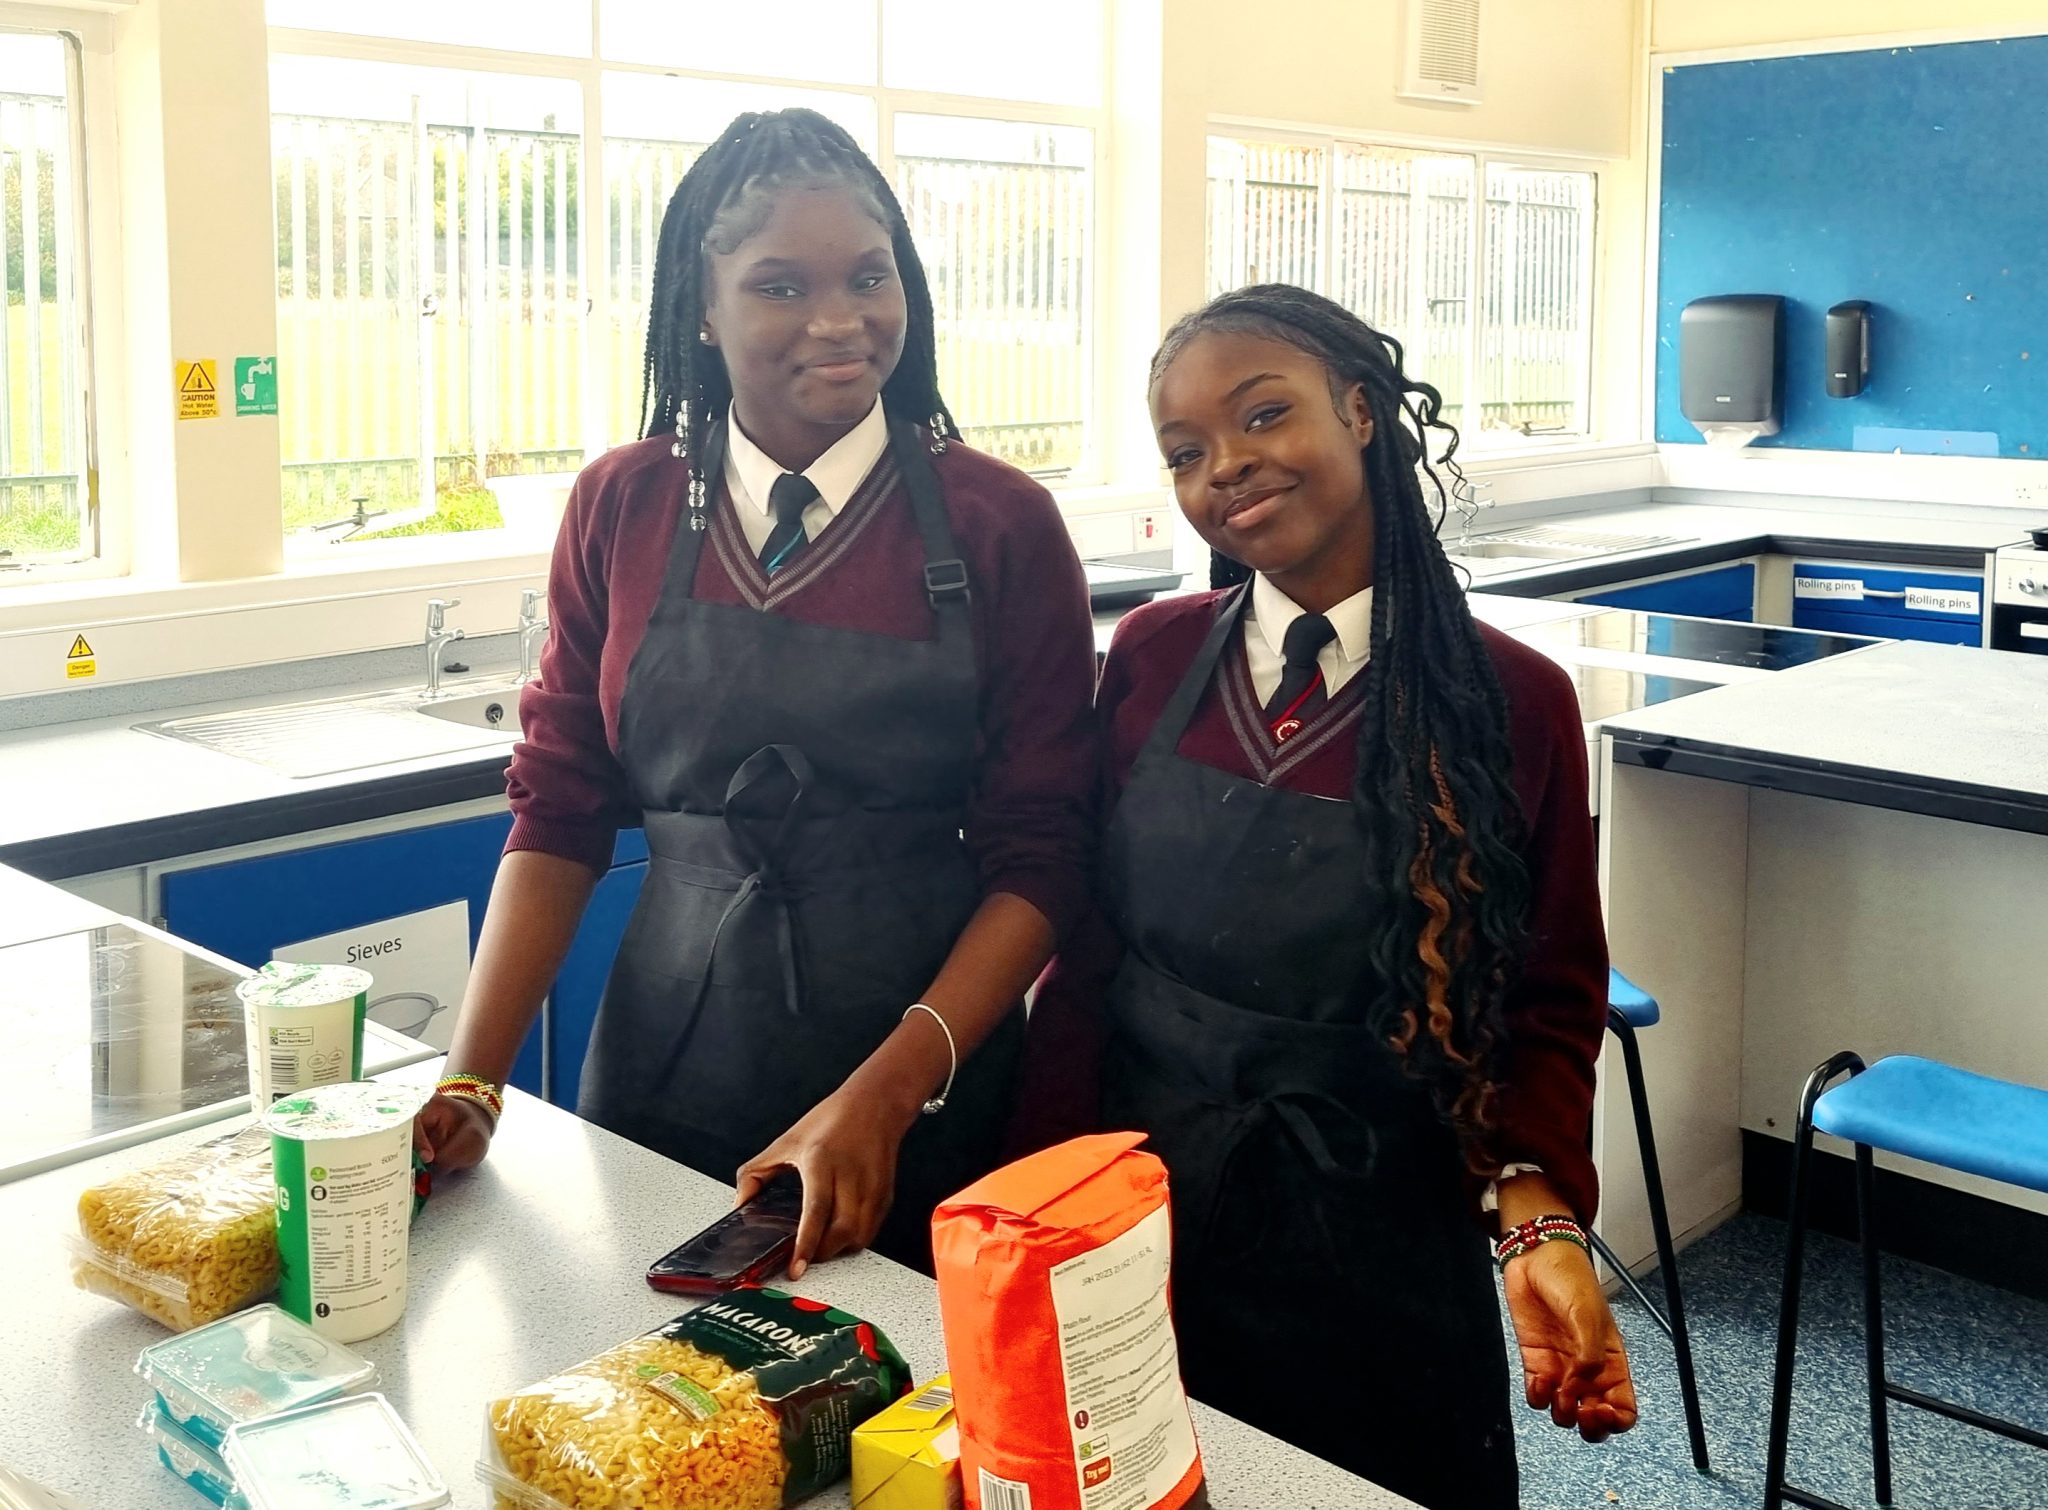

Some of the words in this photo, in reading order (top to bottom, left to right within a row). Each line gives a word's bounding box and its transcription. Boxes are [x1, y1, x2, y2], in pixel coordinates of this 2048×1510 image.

[1798, 578, 1832, 592] Rolling
[1835, 580, 1856, 592] pins
[1909, 593, 1946, 608] Rolling
[1948, 597, 1972, 609] pins
[347, 937, 402, 963] Sieves
[700, 1302, 818, 1357] MACARONI
